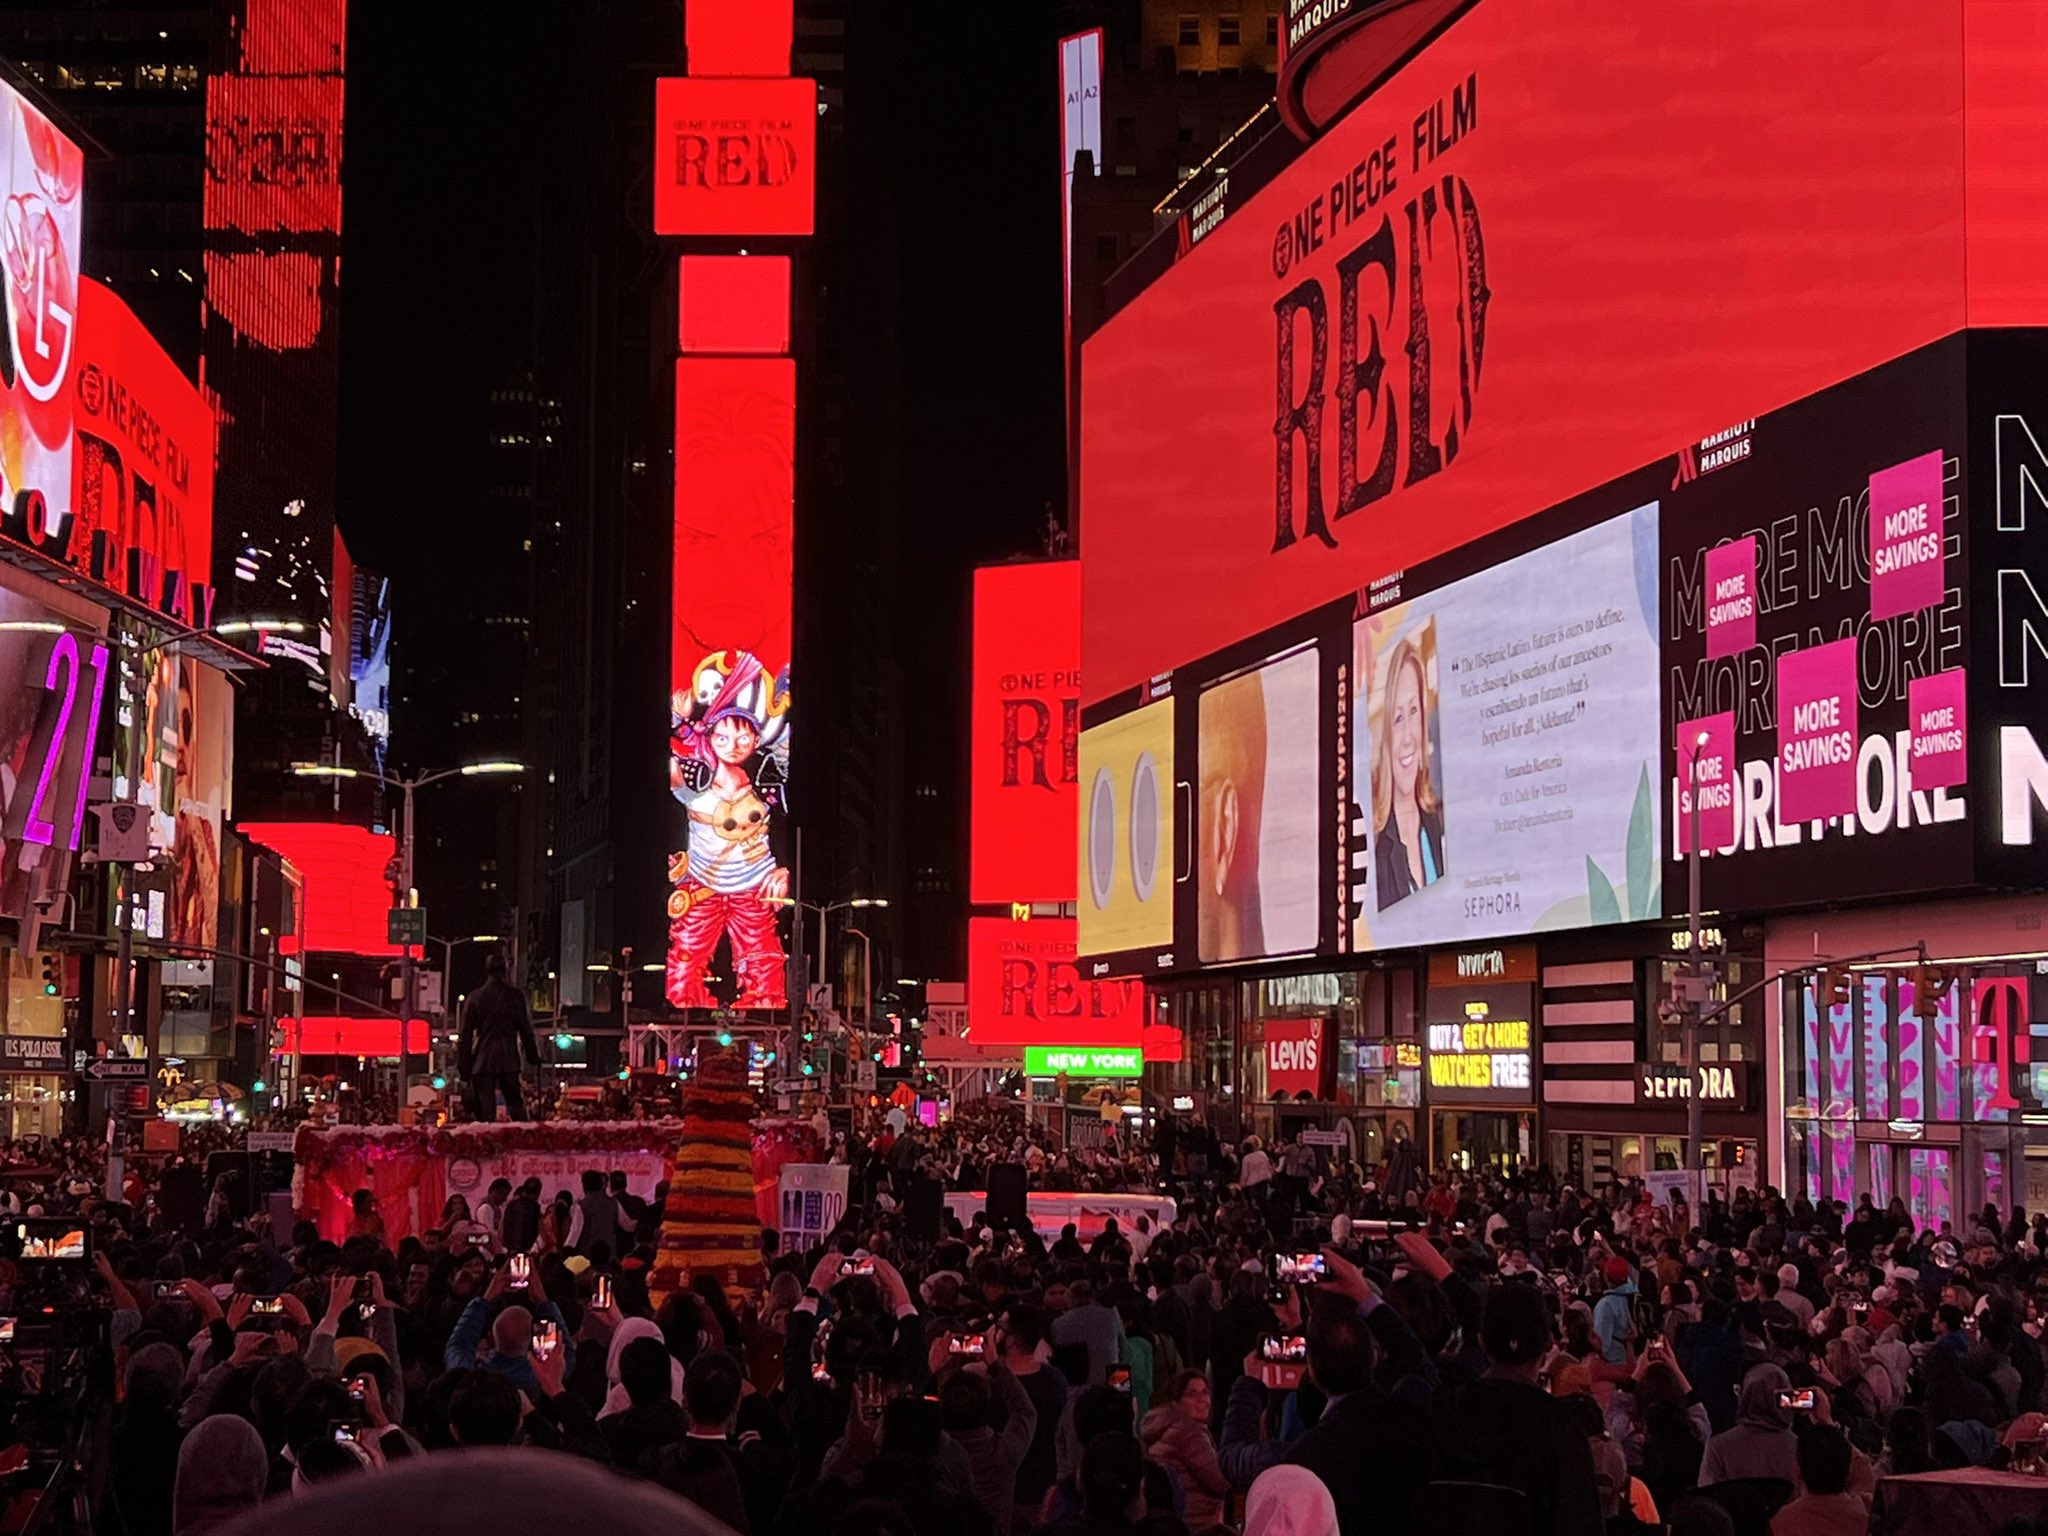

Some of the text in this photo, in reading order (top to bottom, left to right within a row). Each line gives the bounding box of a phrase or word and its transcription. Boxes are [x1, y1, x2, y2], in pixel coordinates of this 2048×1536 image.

[1067, 90, 1079, 105] A1
[1084, 86, 1098, 100] A2
[676, 134, 797, 190] RED
[1273, 71, 1478, 279] ONE PIECE FILM
[1193, 203, 1224, 243] MARQUIS
[1273, 176, 1490, 555] RED
[1701, 439, 1750, 472] MARQUIS
[1885, 504, 1928, 541] MORE
[1874, 532, 1939, 576] SAVINGS
[1670, 515, 1798, 641] MRE
[1716, 574, 1746, 602] MORE
[1709, 596, 1754, 627] SAVINGS
[1000, 673, 1046, 691] ONE
[1794, 697, 1840, 733] MORE
[1920, 706, 1954, 733] MORE
[1783, 731, 1853, 774] SAVINGS
[1913, 732, 1963, 758] SAVINGS
[1465, 891, 1521, 918] SEPHORA
[1458, 950, 1504, 976] INVICTA
[19, 1040, 41, 1058] POLO
[1429, 1024, 1452, 1051] BUY
[1463, 1022, 1486, 1050] GET
[1494, 1021, 1529, 1049] MORE
[94, 1064, 141, 1073] ONE WAY
[1046, 1052, 1137, 1069] NEW YORK
[1429, 1054, 1491, 1087] WATCHES
[1491, 1054, 1530, 1088] FREE
[861, 1073, 875, 1081] 25
